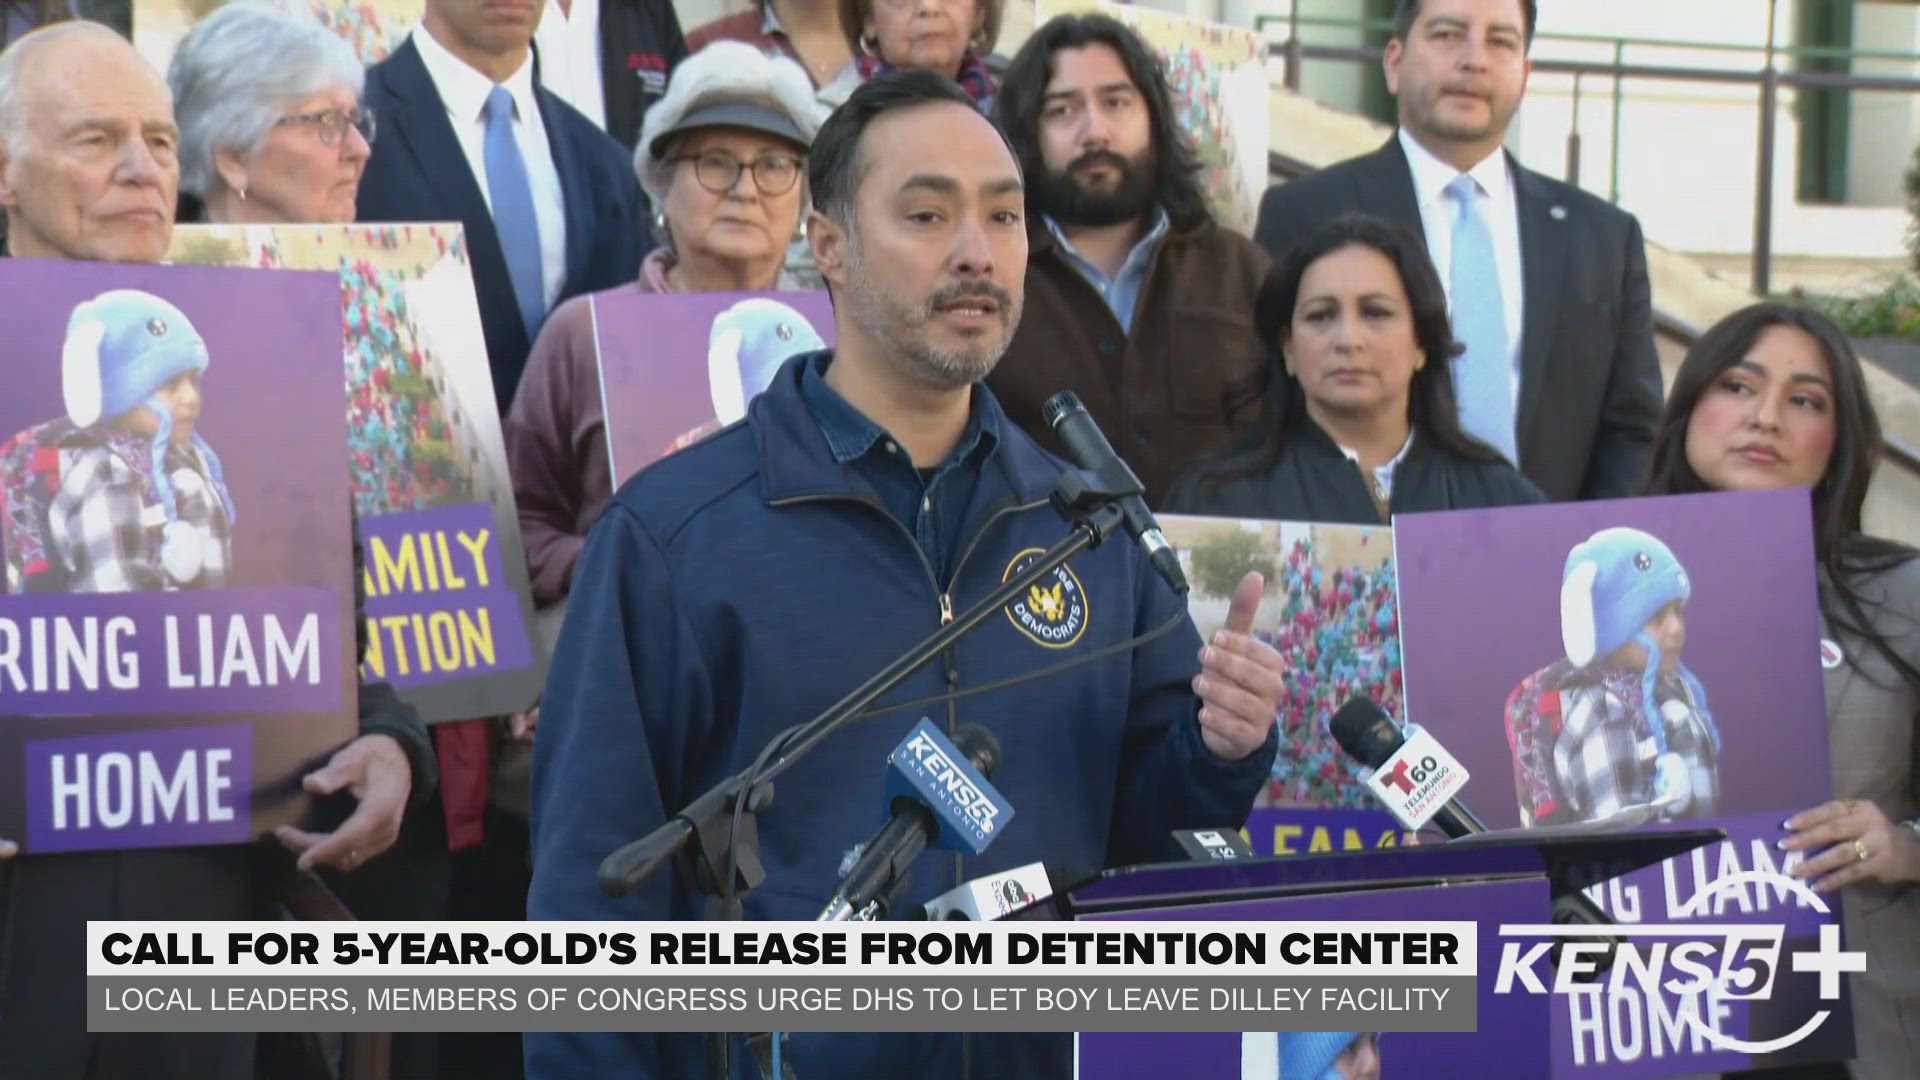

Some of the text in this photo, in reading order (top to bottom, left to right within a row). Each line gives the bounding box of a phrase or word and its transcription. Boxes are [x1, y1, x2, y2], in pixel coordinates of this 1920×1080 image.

[1014, 602, 1081, 639] DEMOCRATS
[165, 612, 321, 689] LIAM
[51, 747, 235, 831] HOME
[1403, 765, 1449, 811] TELEMUNDO
[1410, 755, 1437, 783] 60
[901, 751, 985, 841] SAN ANTONIO
[1409, 771, 1457, 819] SAN ANTONIO
